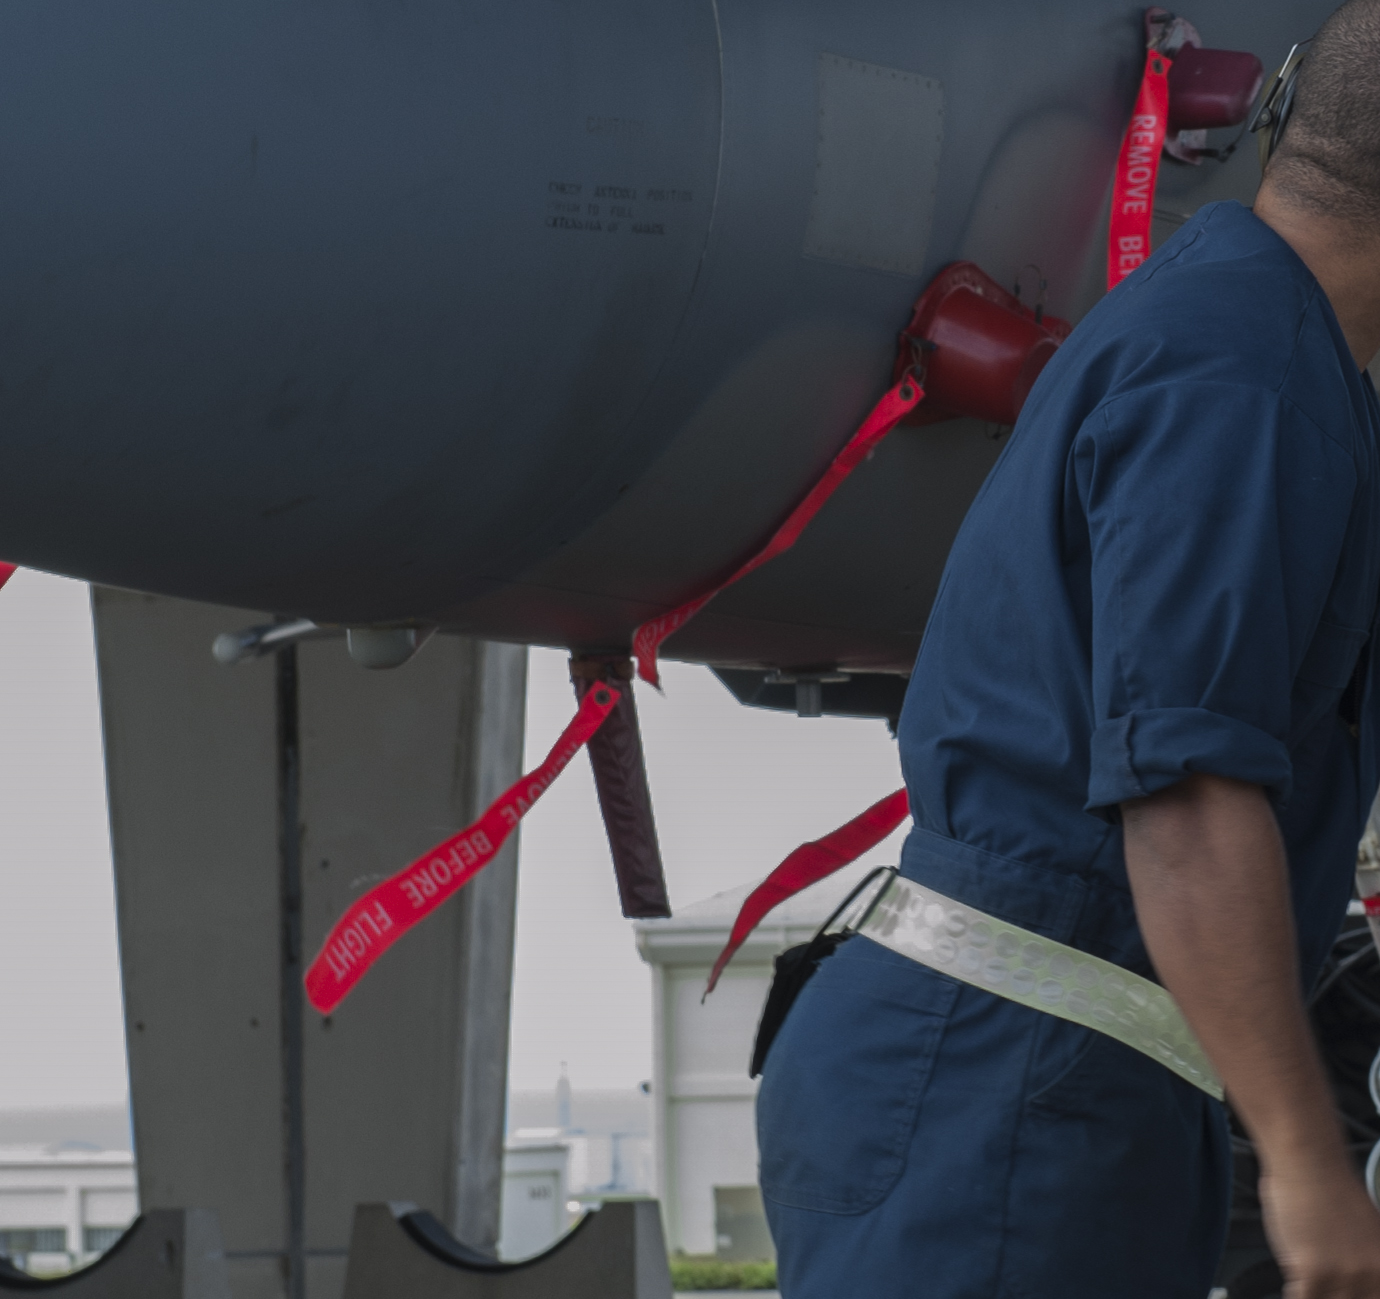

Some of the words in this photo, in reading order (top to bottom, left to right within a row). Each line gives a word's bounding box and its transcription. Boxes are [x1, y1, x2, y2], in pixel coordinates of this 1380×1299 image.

[1123, 114, 1157, 215] REMOVE
[397, 828, 494, 910] BEFORE
[325, 900, 394, 984] FLIGHT
